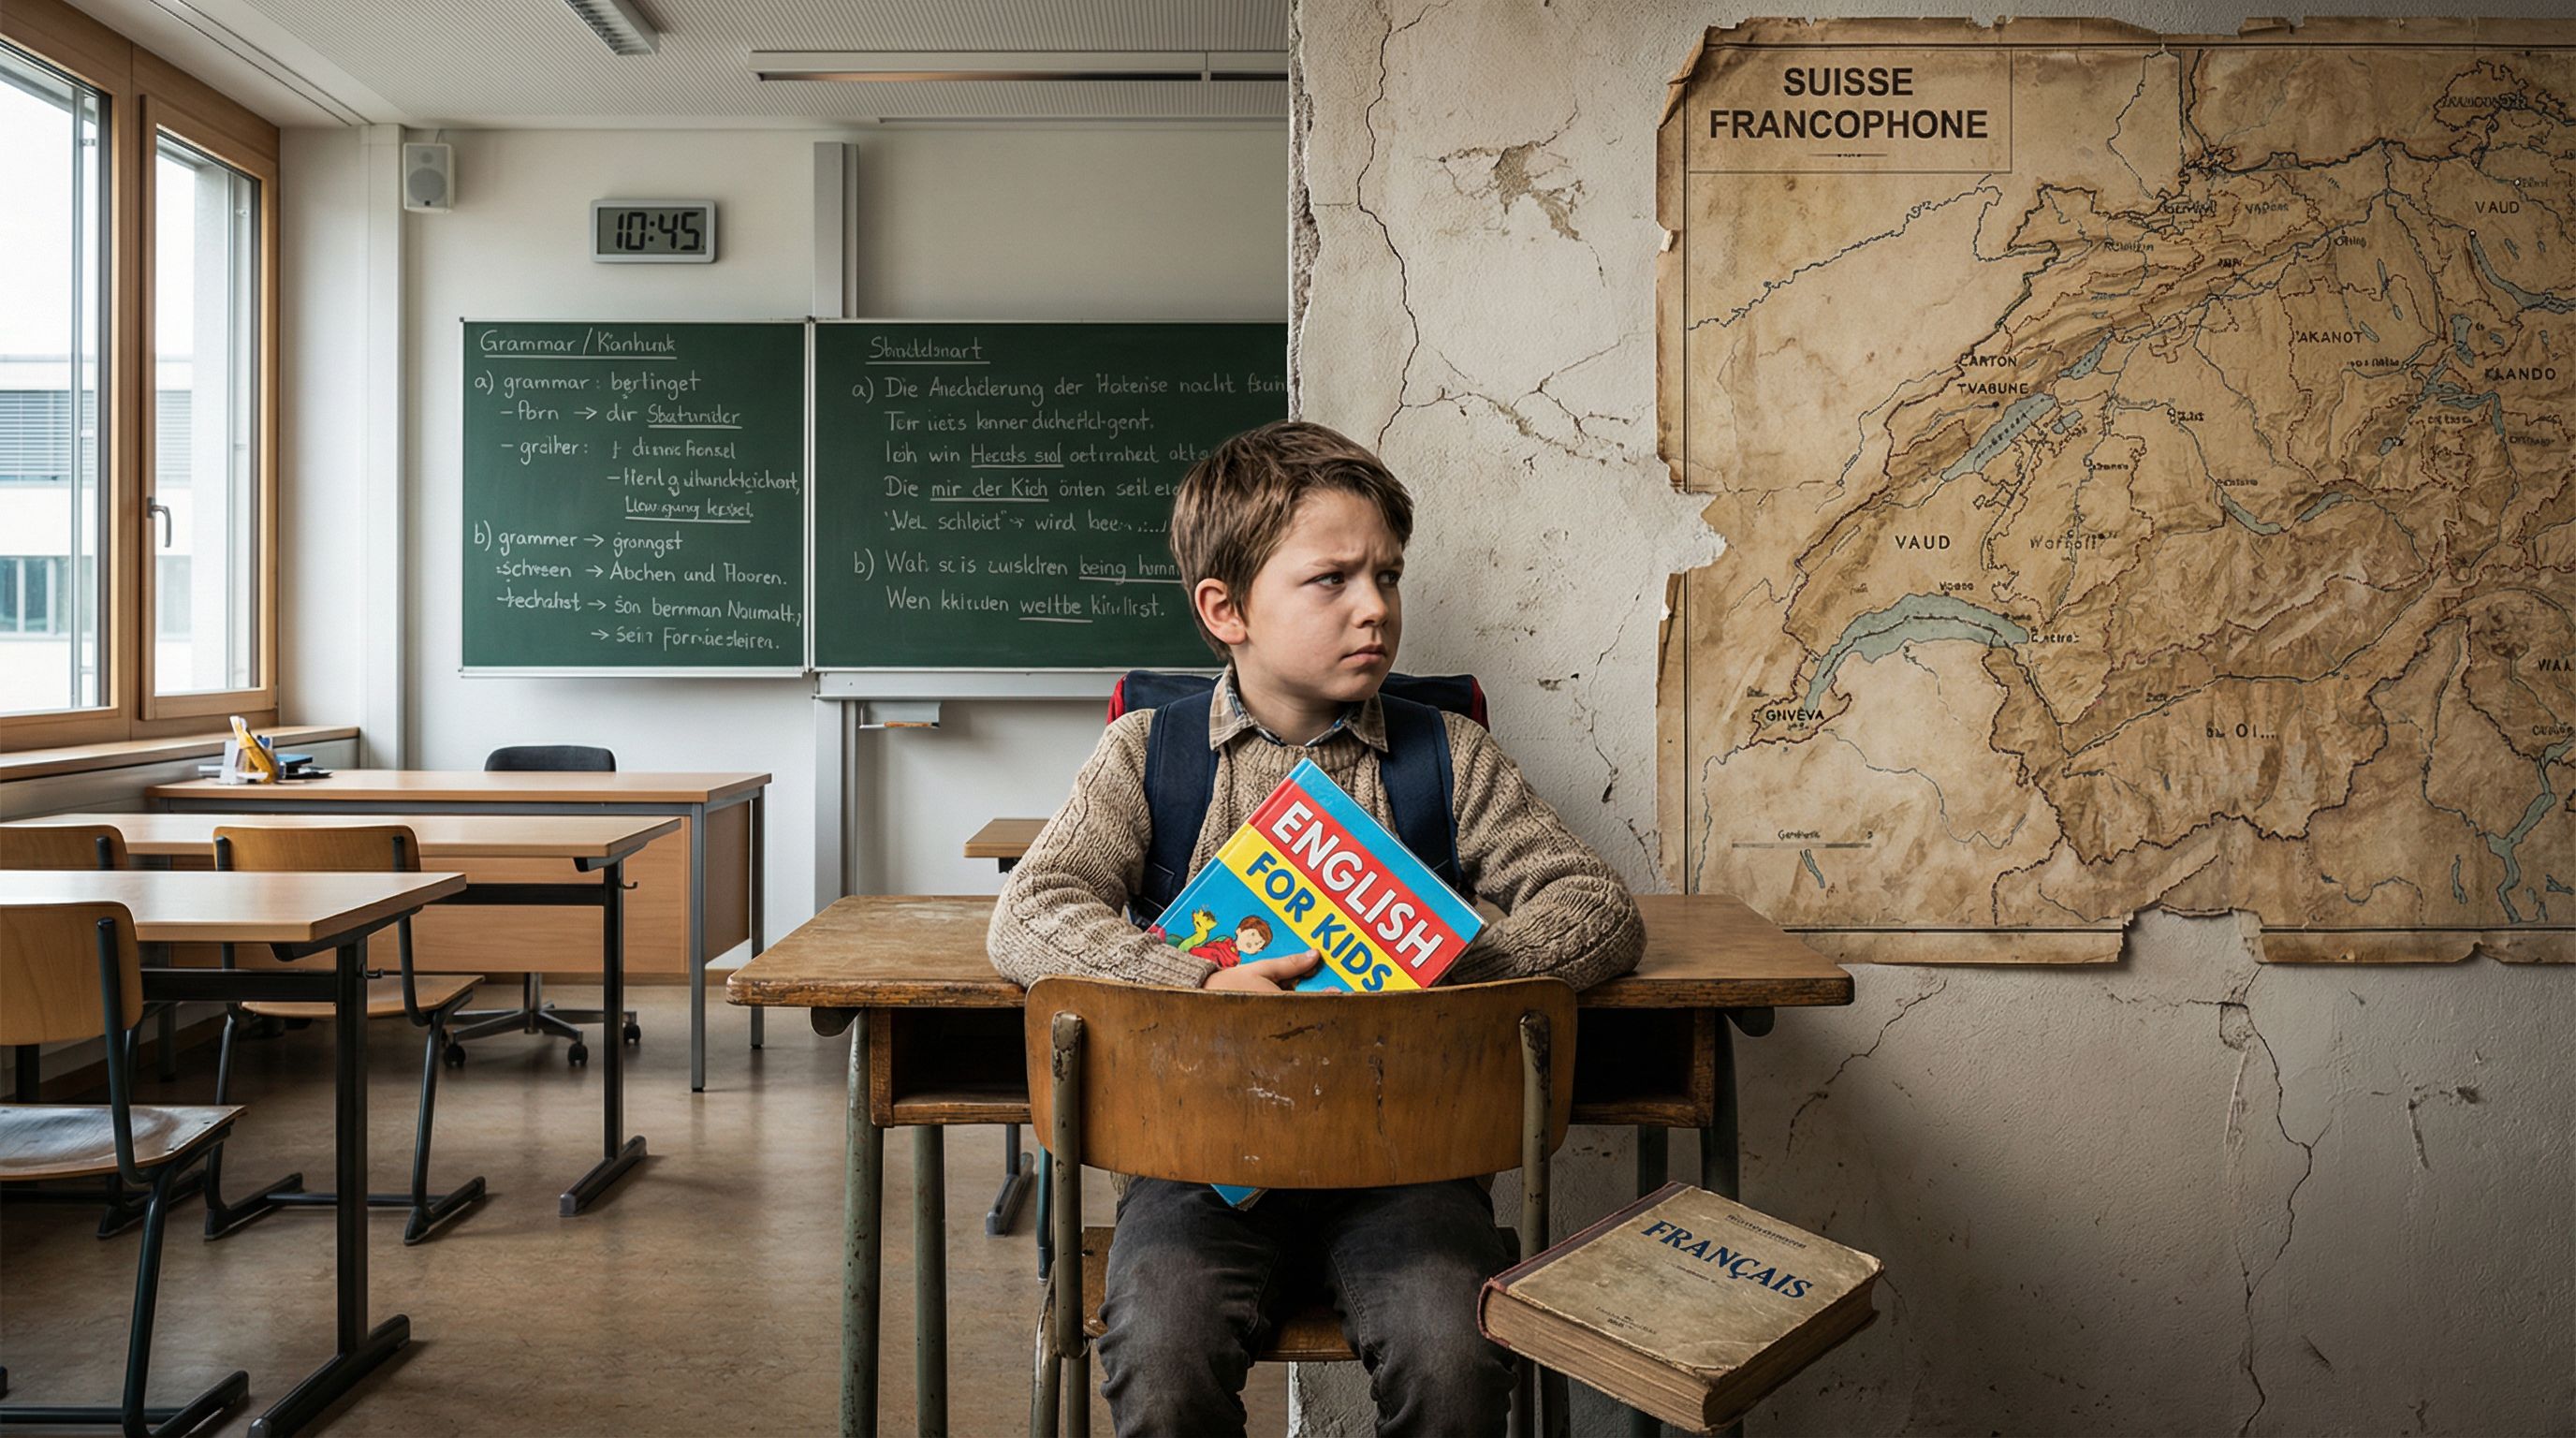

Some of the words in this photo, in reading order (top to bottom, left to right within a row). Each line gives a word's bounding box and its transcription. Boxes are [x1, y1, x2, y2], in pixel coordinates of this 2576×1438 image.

[1783, 66, 1914, 97] SUISSE
[1708, 110, 1989, 139] FRANCOPHONE
[2475, 201, 2520, 213] VAUD
[616, 212, 700, 250] 10:45
[479, 329, 577, 353] Grammar
[474, 369, 494, 395] a)
[852, 373, 875, 404] a)
[885, 375, 919, 399] Die
[1054, 375, 1084, 395] der
[885, 475, 919, 498] Die
[973, 477, 1003, 498] der
[474, 520, 492, 551] b)
[1034, 510, 1076, 532] wird
[1895, 535, 1951, 550] VAUD
[854, 550, 875, 581] b)
[886, 586, 930, 611] Wen
[1271, 800, 1444, 969] ENGLISH
[1246, 850, 1317, 923] FOR
[1310, 912, 1393, 992] KIDS
[1641, 1220, 1813, 1299] FRANÇAIS
